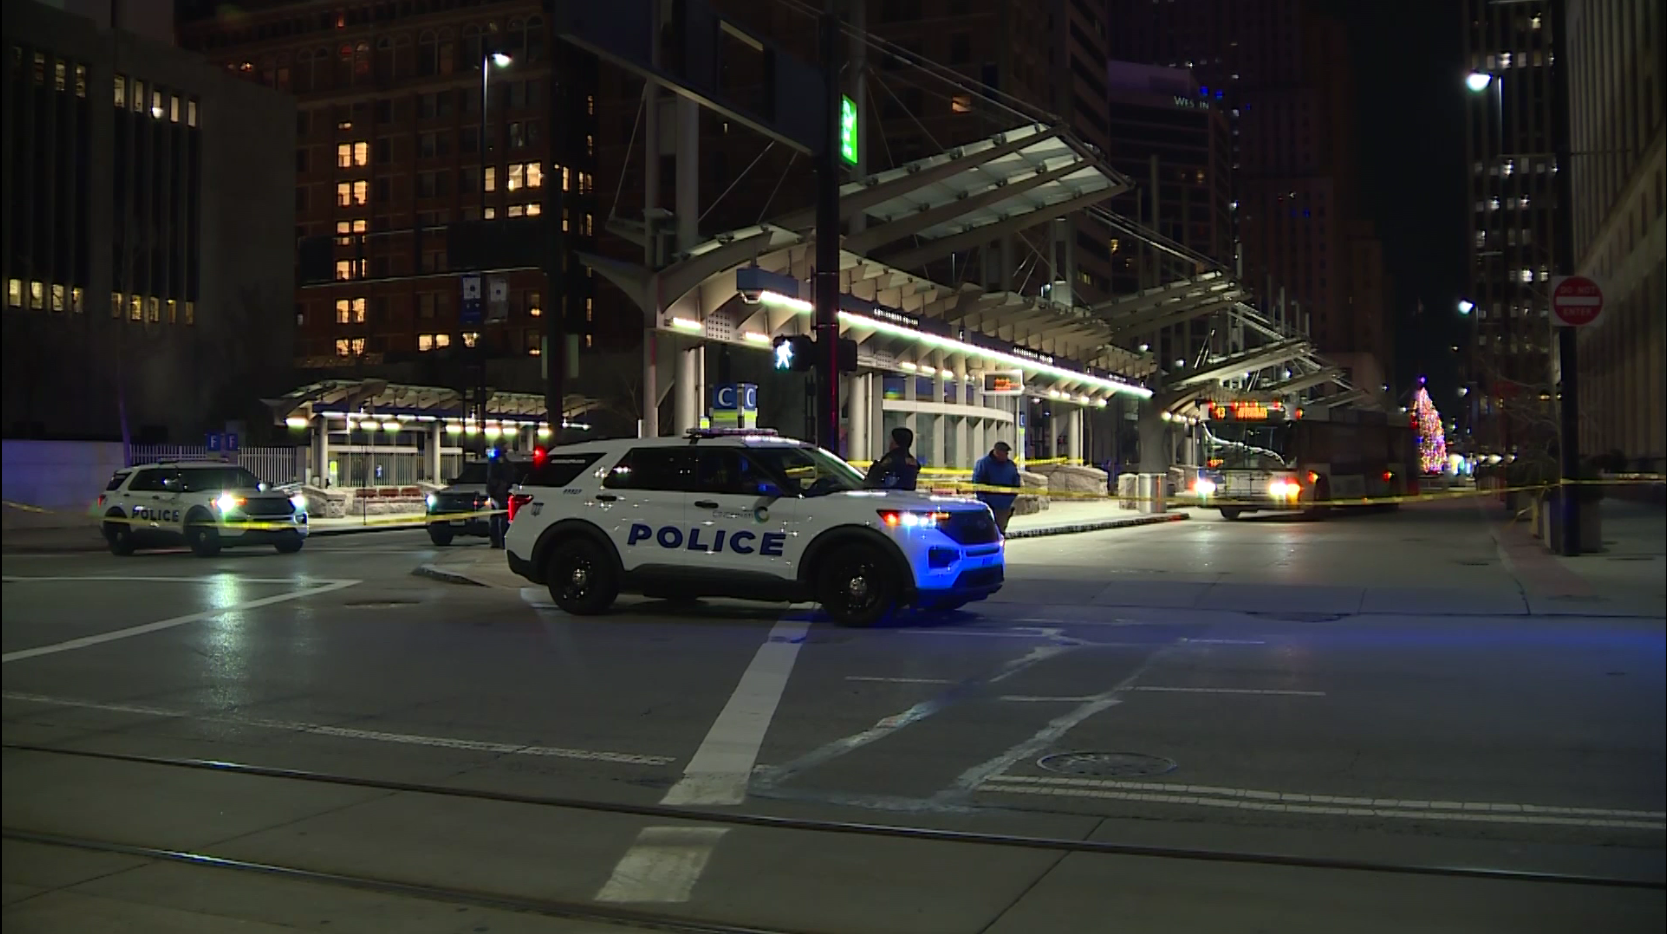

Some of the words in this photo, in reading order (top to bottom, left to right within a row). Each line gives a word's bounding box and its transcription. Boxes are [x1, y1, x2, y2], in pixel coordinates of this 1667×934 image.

[1173, 95, 1209, 109] WESIN
[1560, 286, 1572, 294] DO
[1577, 286, 1595, 294] NOT
[1563, 307, 1591, 316] ENTER
[718, 386, 733, 407] C
[746, 387, 755, 408] C
[210, 435, 217, 448] F
[229, 435, 236, 448] F
[131, 505, 180, 523] POLICE
[627, 523, 787, 556] POLICE
